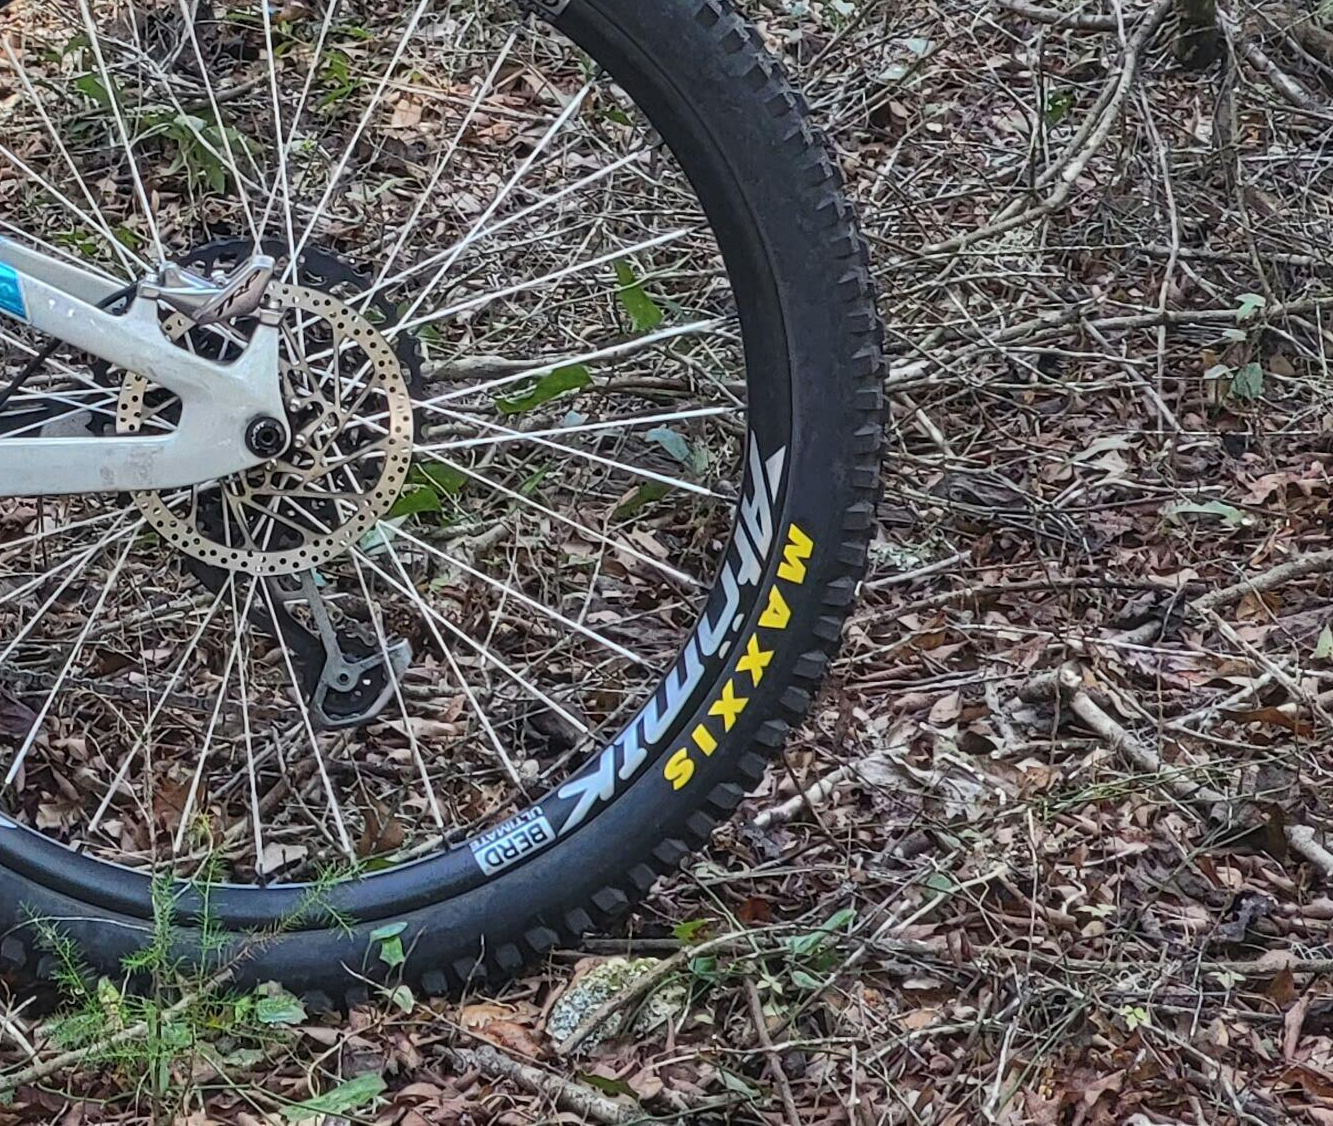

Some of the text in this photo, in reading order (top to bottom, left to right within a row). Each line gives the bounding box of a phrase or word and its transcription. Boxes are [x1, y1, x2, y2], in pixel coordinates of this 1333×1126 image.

[664, 523, 814, 791] MAXXIS
[469, 805, 544, 853] ULTIMATE
[484, 822, 549, 868] BERD
